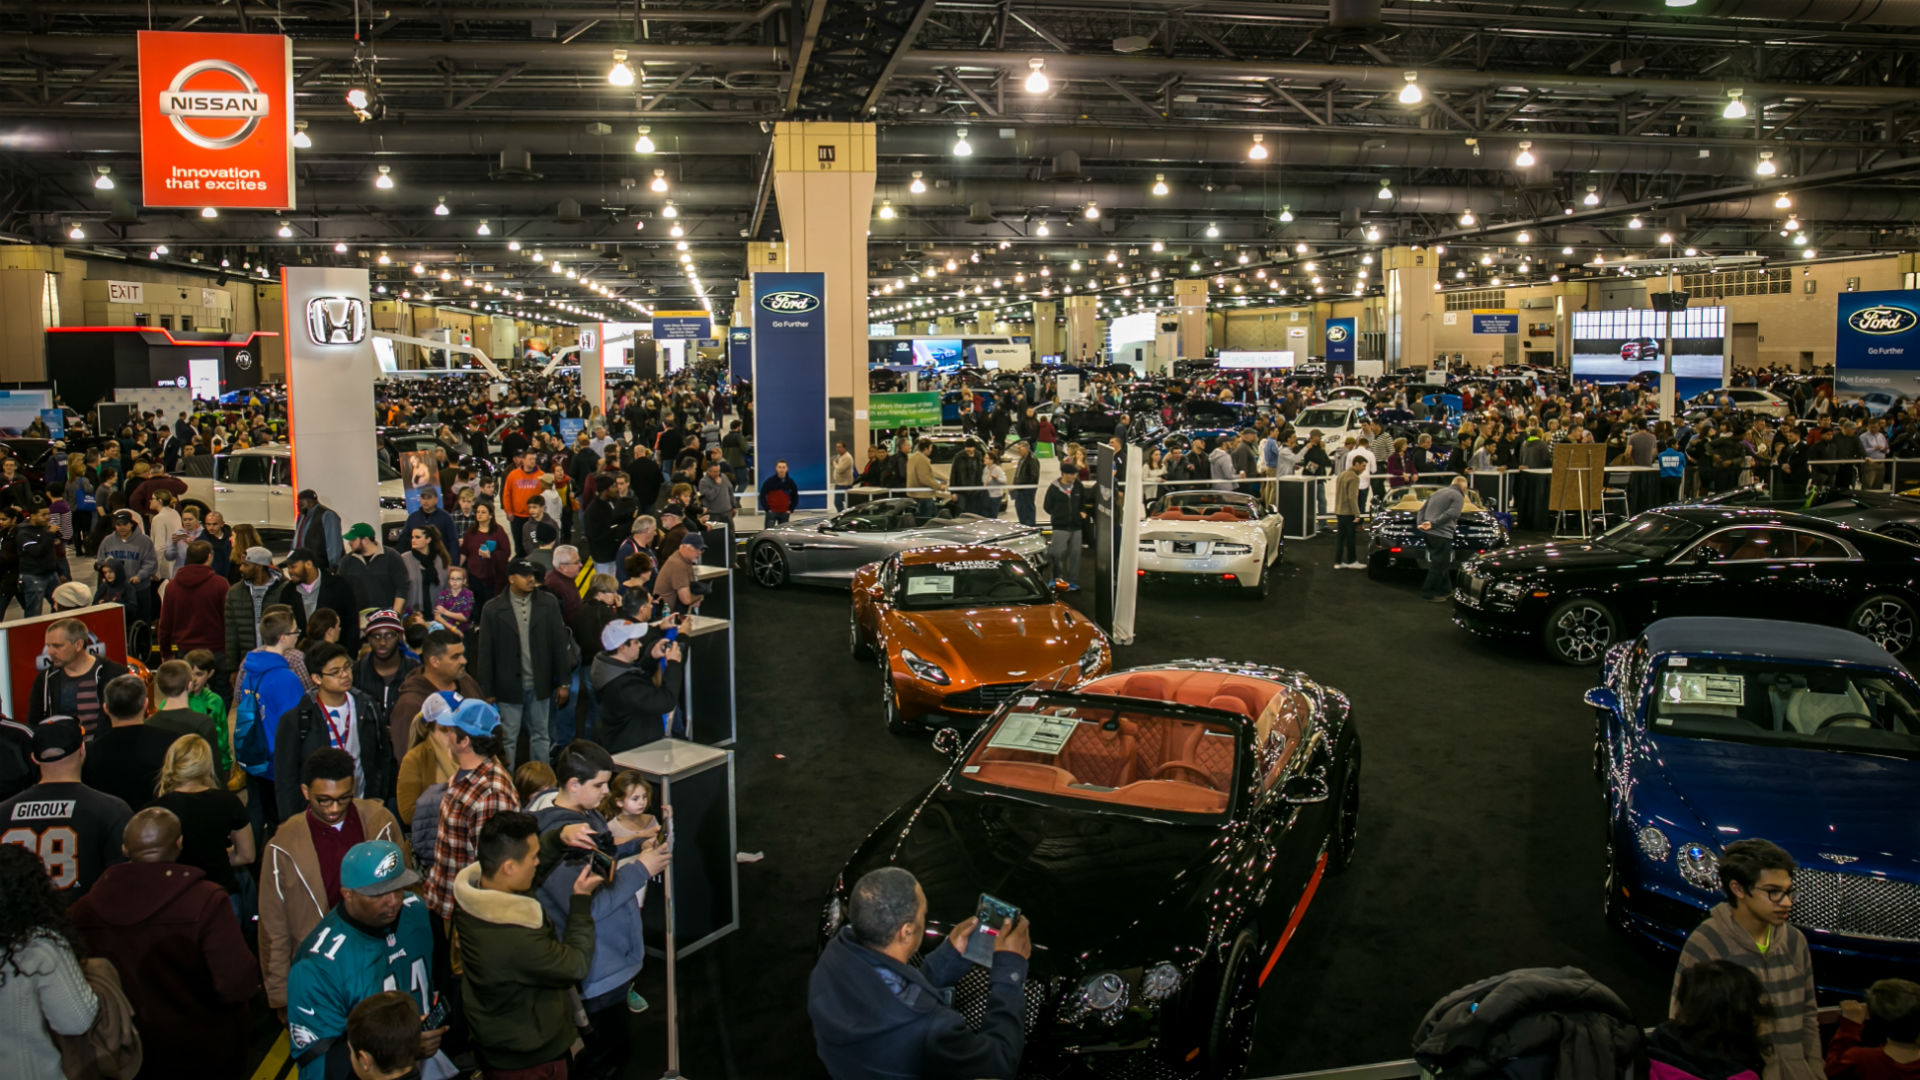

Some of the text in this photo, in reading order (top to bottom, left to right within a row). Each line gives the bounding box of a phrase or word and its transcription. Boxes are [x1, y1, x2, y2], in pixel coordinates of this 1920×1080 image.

[171, 96, 258, 111] NISSAN
[172, 165, 261, 179] Innovation
[165, 178, 268, 191] that excites
[110, 284, 140, 299] EXIT
[771, 294, 809, 309] Ford
[1859, 310, 1902, 329] Ford
[17, 802, 70, 818] GIROUX
[309, 926, 347, 961] 11
